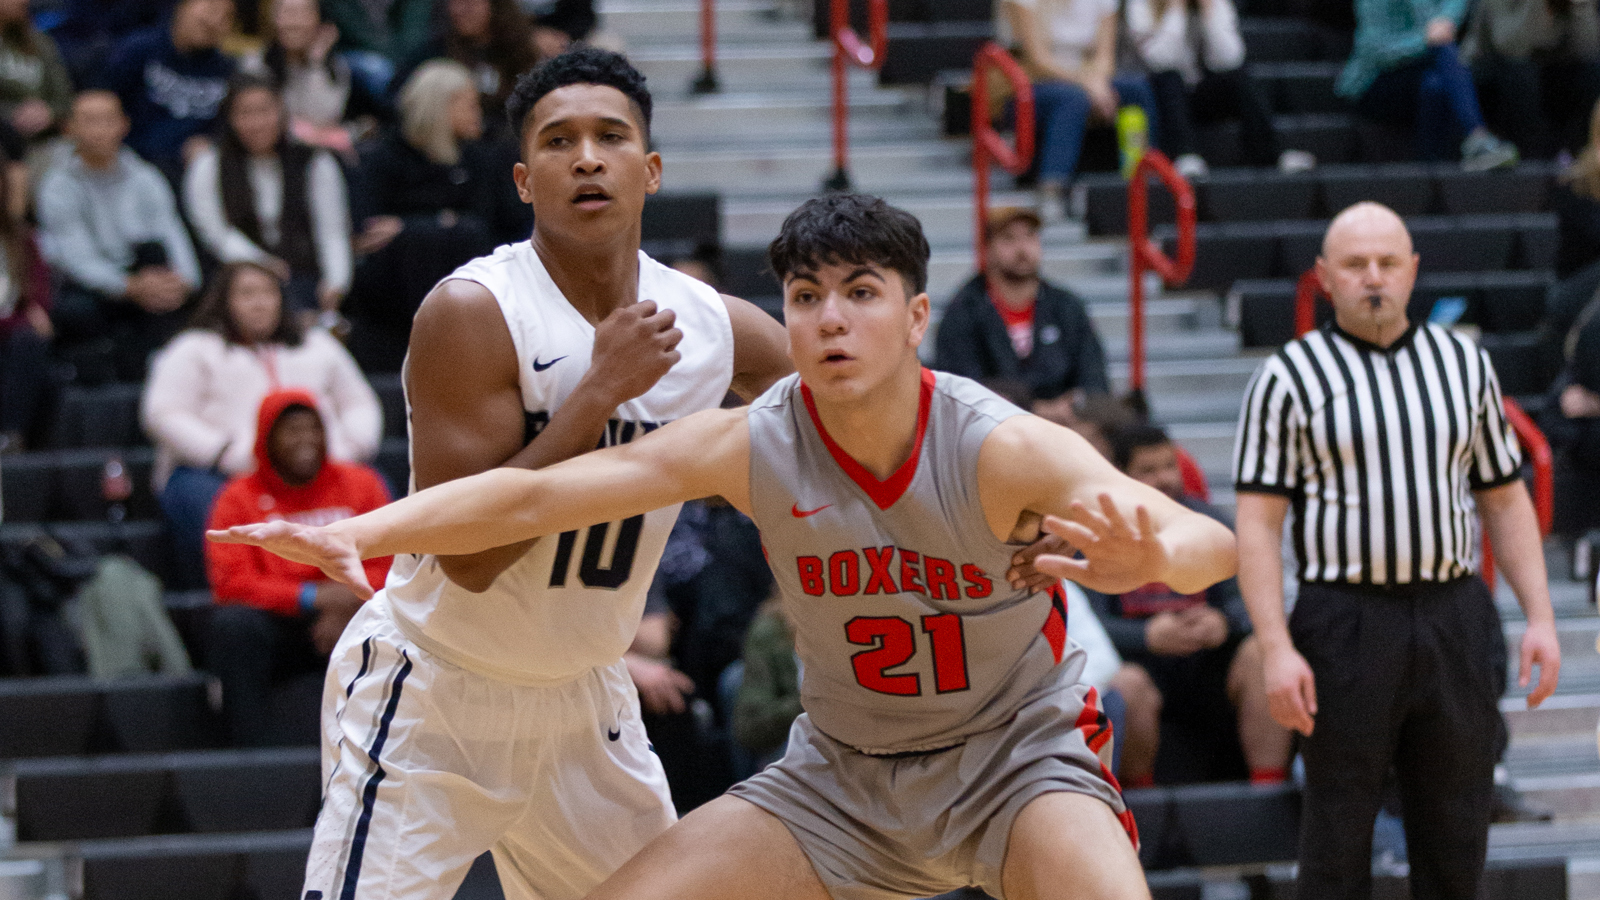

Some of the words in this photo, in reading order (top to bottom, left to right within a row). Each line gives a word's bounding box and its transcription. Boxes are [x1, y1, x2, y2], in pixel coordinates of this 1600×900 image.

[548, 512, 646, 591] 10
[796, 545, 994, 601] BOXERS
[844, 613, 970, 697] 21
